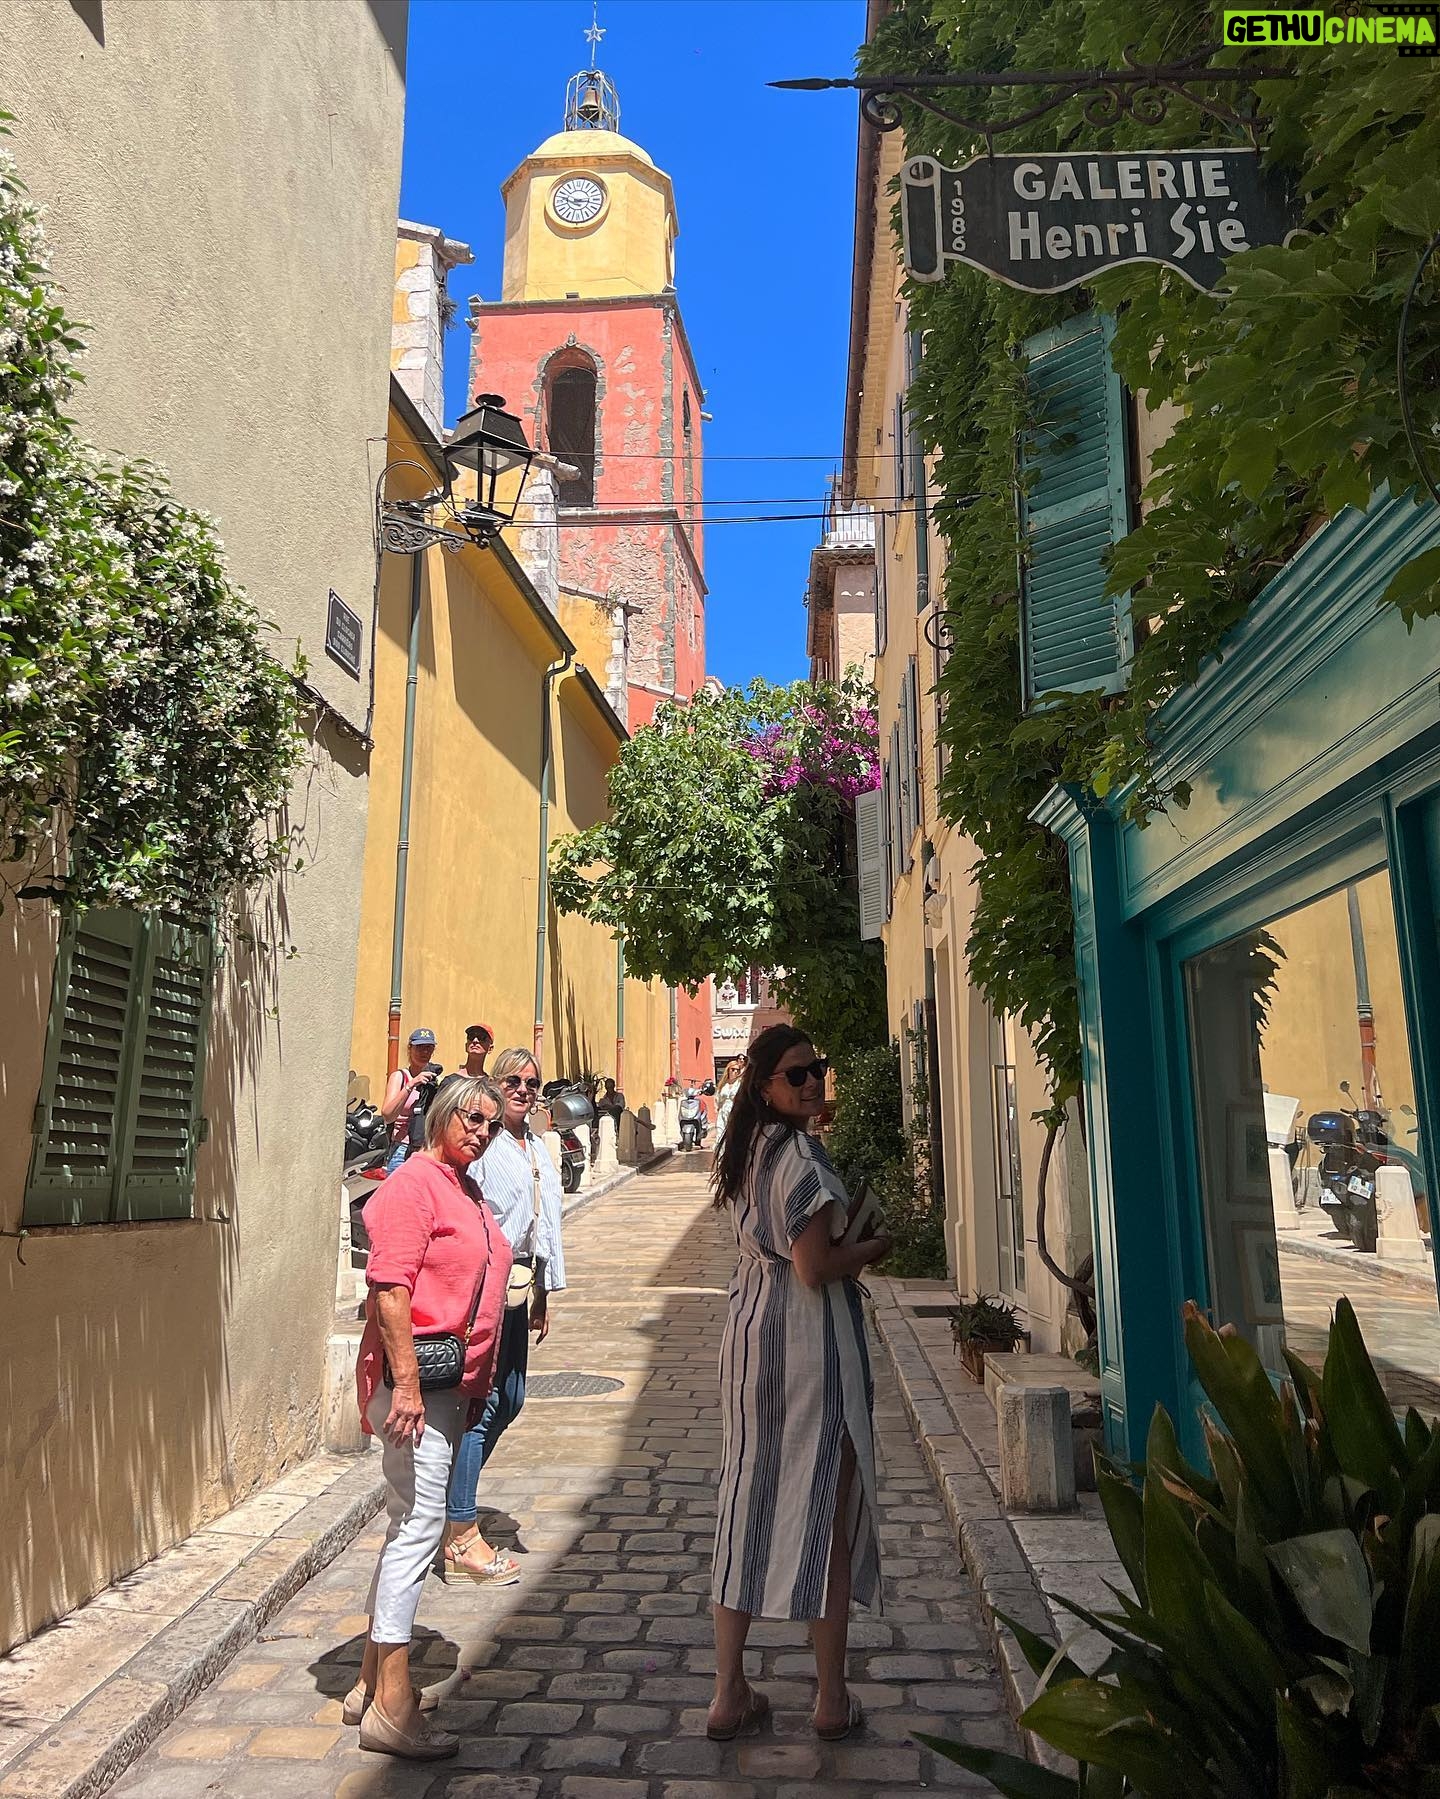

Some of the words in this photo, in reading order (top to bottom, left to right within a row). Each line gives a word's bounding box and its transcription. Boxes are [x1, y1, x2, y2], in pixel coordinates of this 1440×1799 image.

[1012, 159, 1231, 201] GALERIE
[950, 179, 967, 253] 1986
[1007, 206, 1148, 261] Henri
[1169, 200, 1252, 260] Sié
